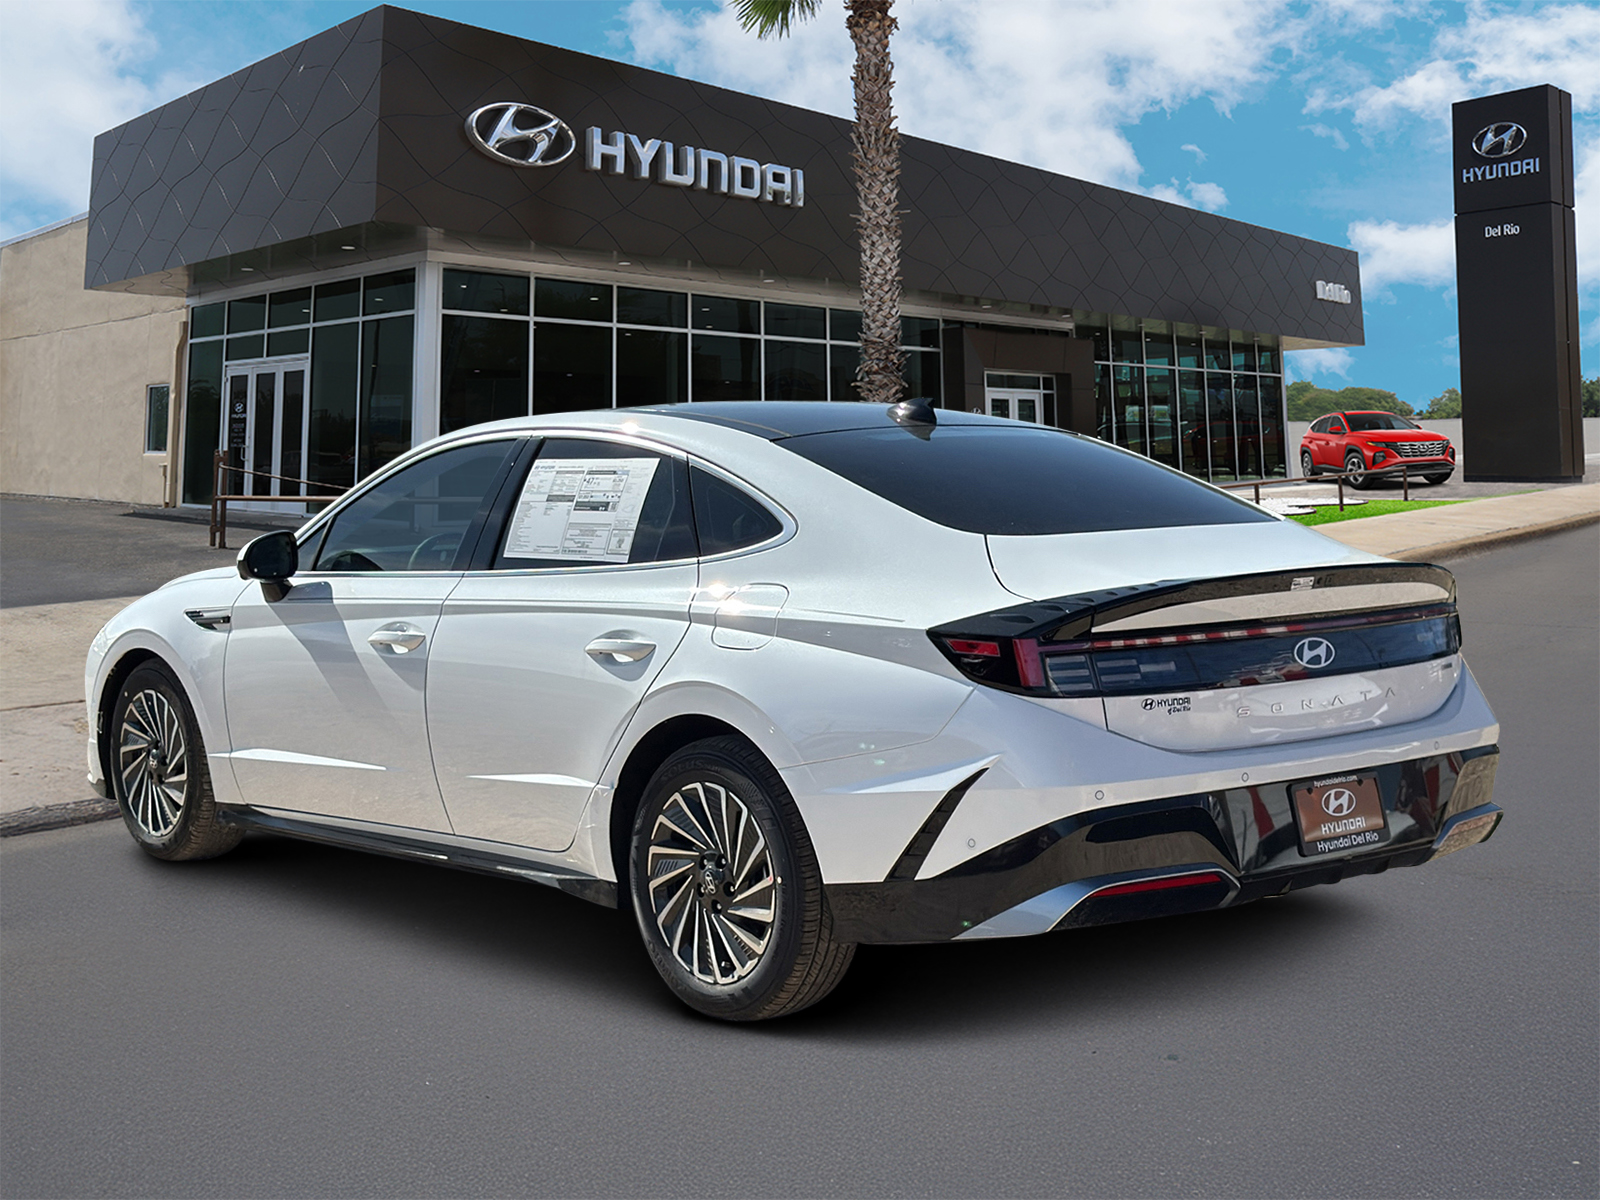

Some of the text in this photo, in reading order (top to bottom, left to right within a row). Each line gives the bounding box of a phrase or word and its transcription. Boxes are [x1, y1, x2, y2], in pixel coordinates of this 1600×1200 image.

[586, 126, 804, 208] HYUNDAI
[1462, 157, 1540, 183] HYUNDAI
[1484, 223, 1520, 238] Del Rio
[1157, 697, 1191, 707] HYUNDAI
[1237, 687, 1396, 718] SONATA
[1321, 816, 1366, 834] HYUNDAI
[1317, 831, 1378, 852] Hyundai Del Rio
